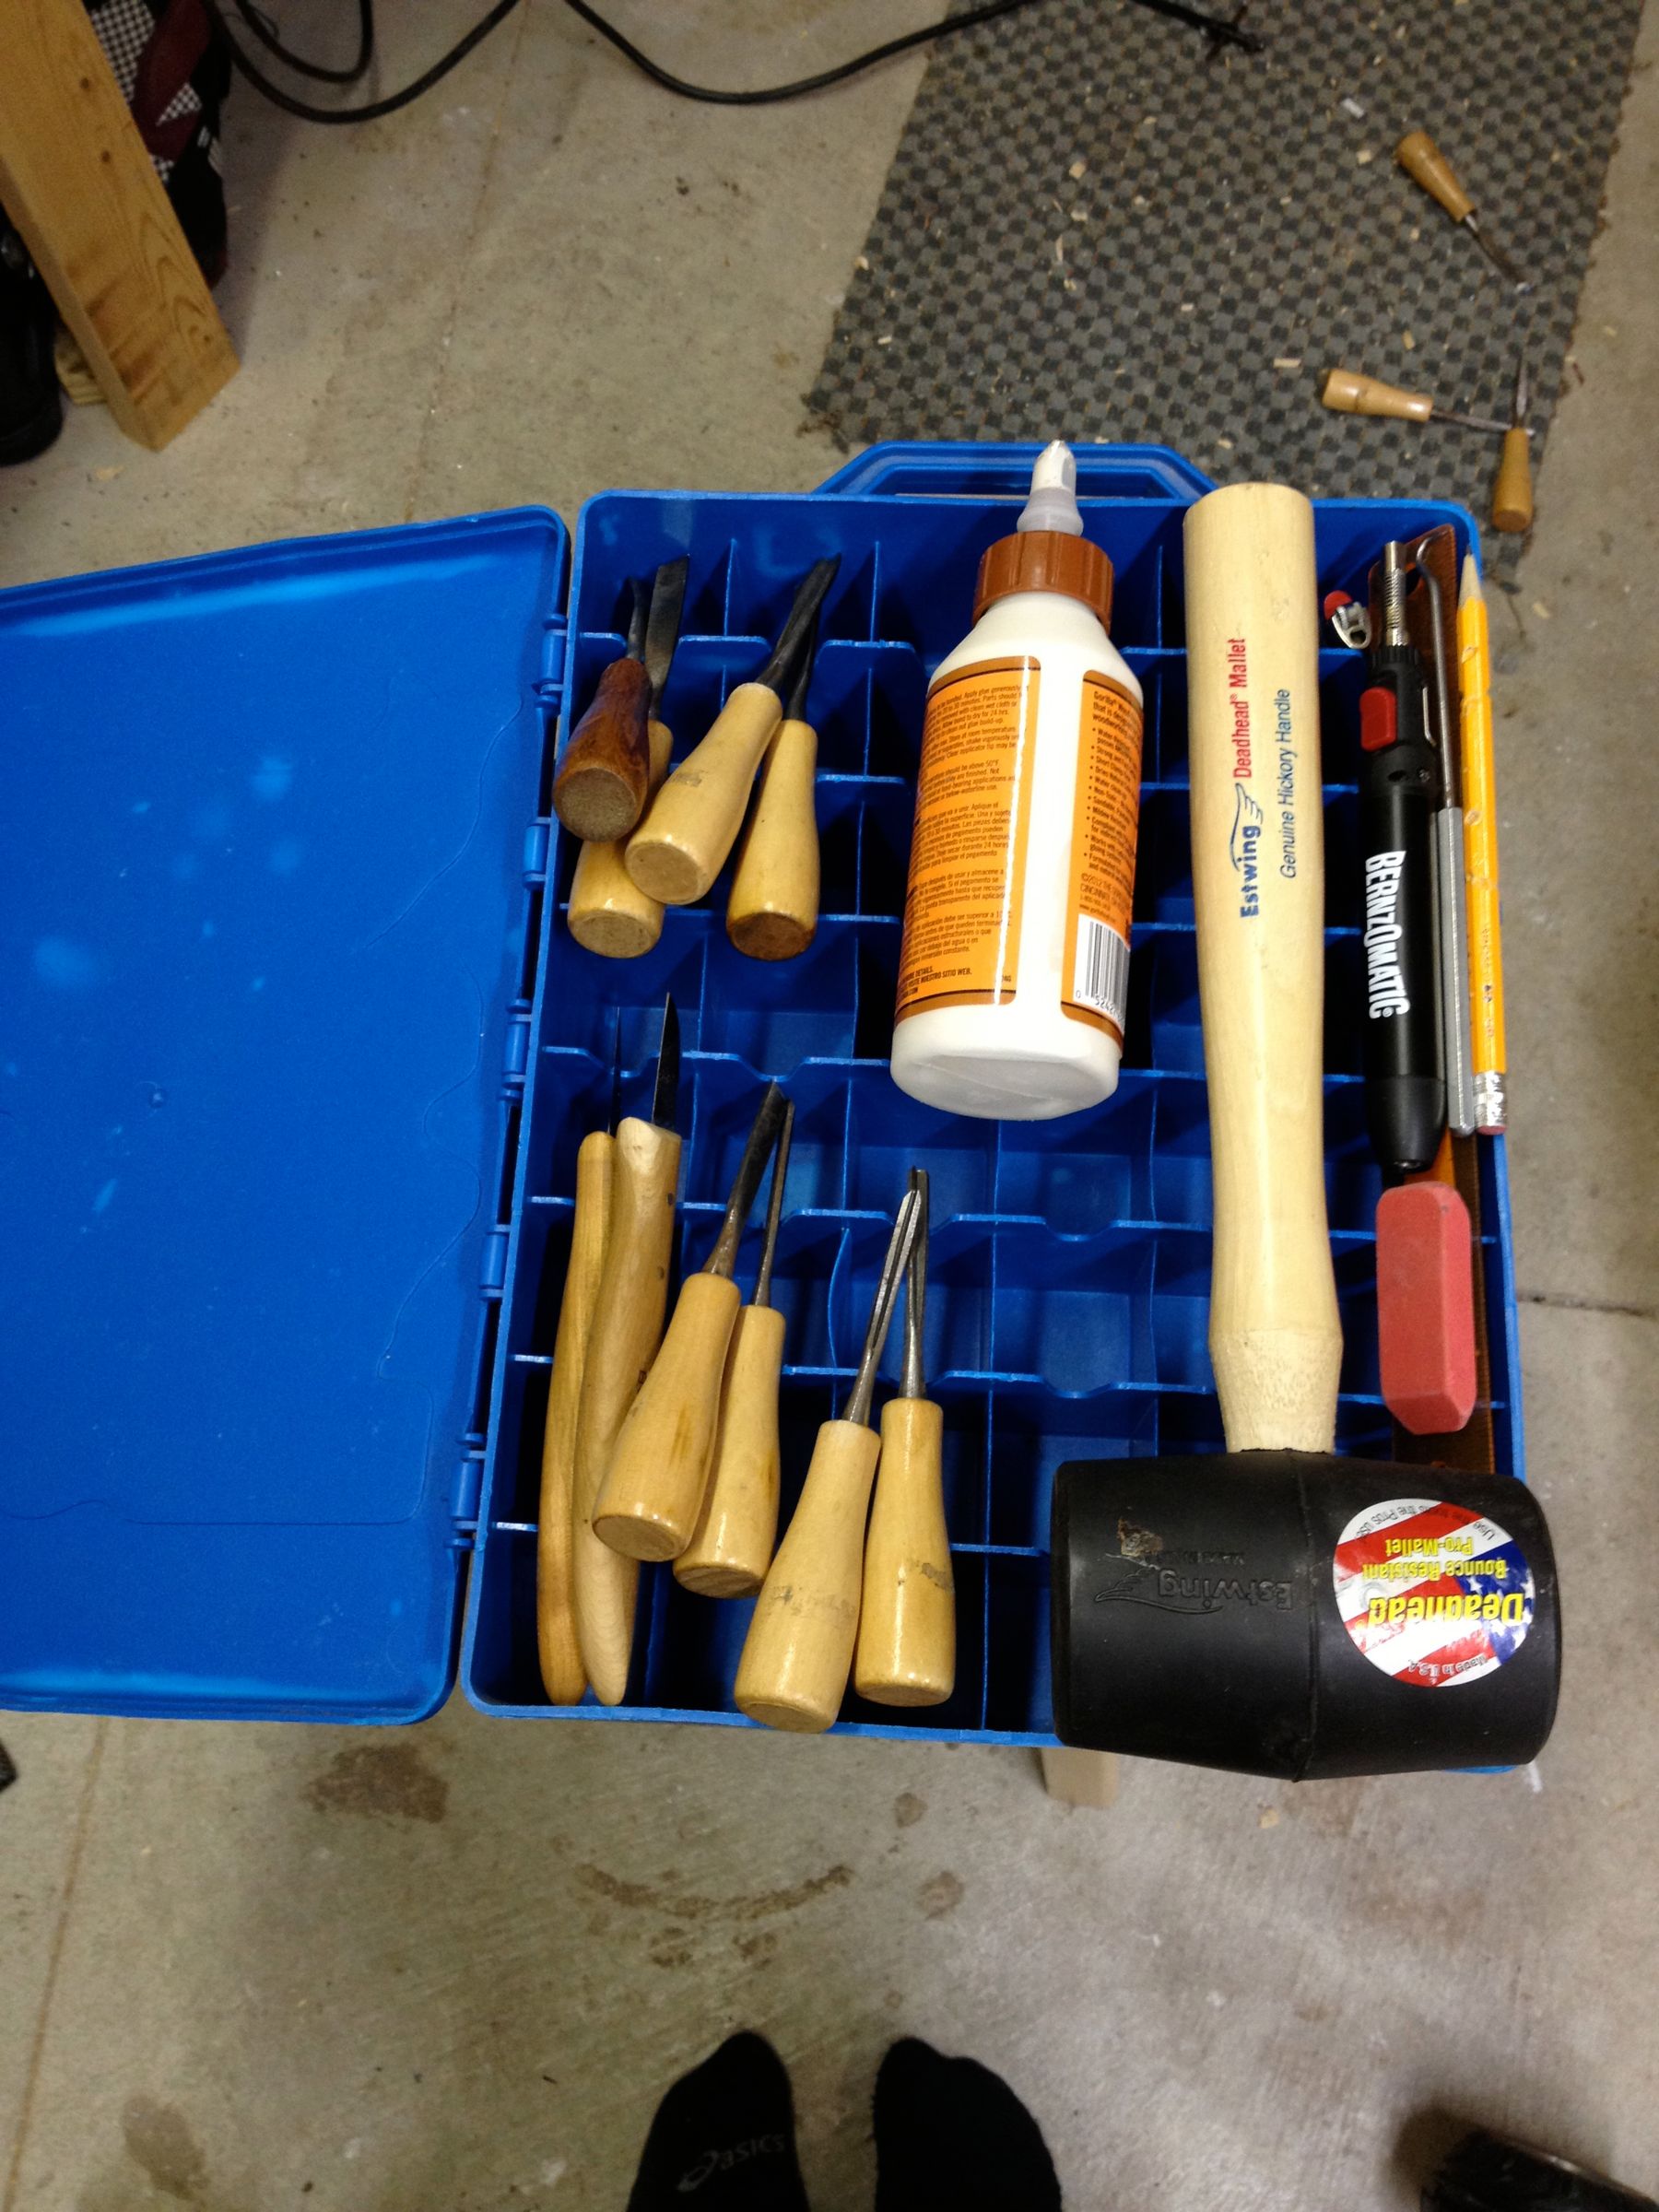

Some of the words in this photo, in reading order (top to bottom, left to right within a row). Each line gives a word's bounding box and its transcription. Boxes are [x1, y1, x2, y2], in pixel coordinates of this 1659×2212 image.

[1228, 638, 1248, 688] Mallet
[1274, 688, 1292, 743] Handle
[1277, 747, 1298, 806] Hickory
[1278, 811, 1297, 878] Genuine
[1236, 825, 1262, 917] Estwing
[1364, 850, 1411, 1019] BERNZOMATIC
[1371, 1509, 1398, 1524] Pros
[1473, 1522, 1496, 1541] Use
[1384, 1536, 1473, 1558] Pro-Mallet
[1158, 1568, 1293, 1612] Estwing
[1361, 1561, 1441, 1585] Resistant
[1444, 1559, 1508, 1583] Bounce
[1442, 1664, 1454, 1677] in
[1456, 1655, 1488, 1674] Made
[719, 2132, 786, 2171] asics
